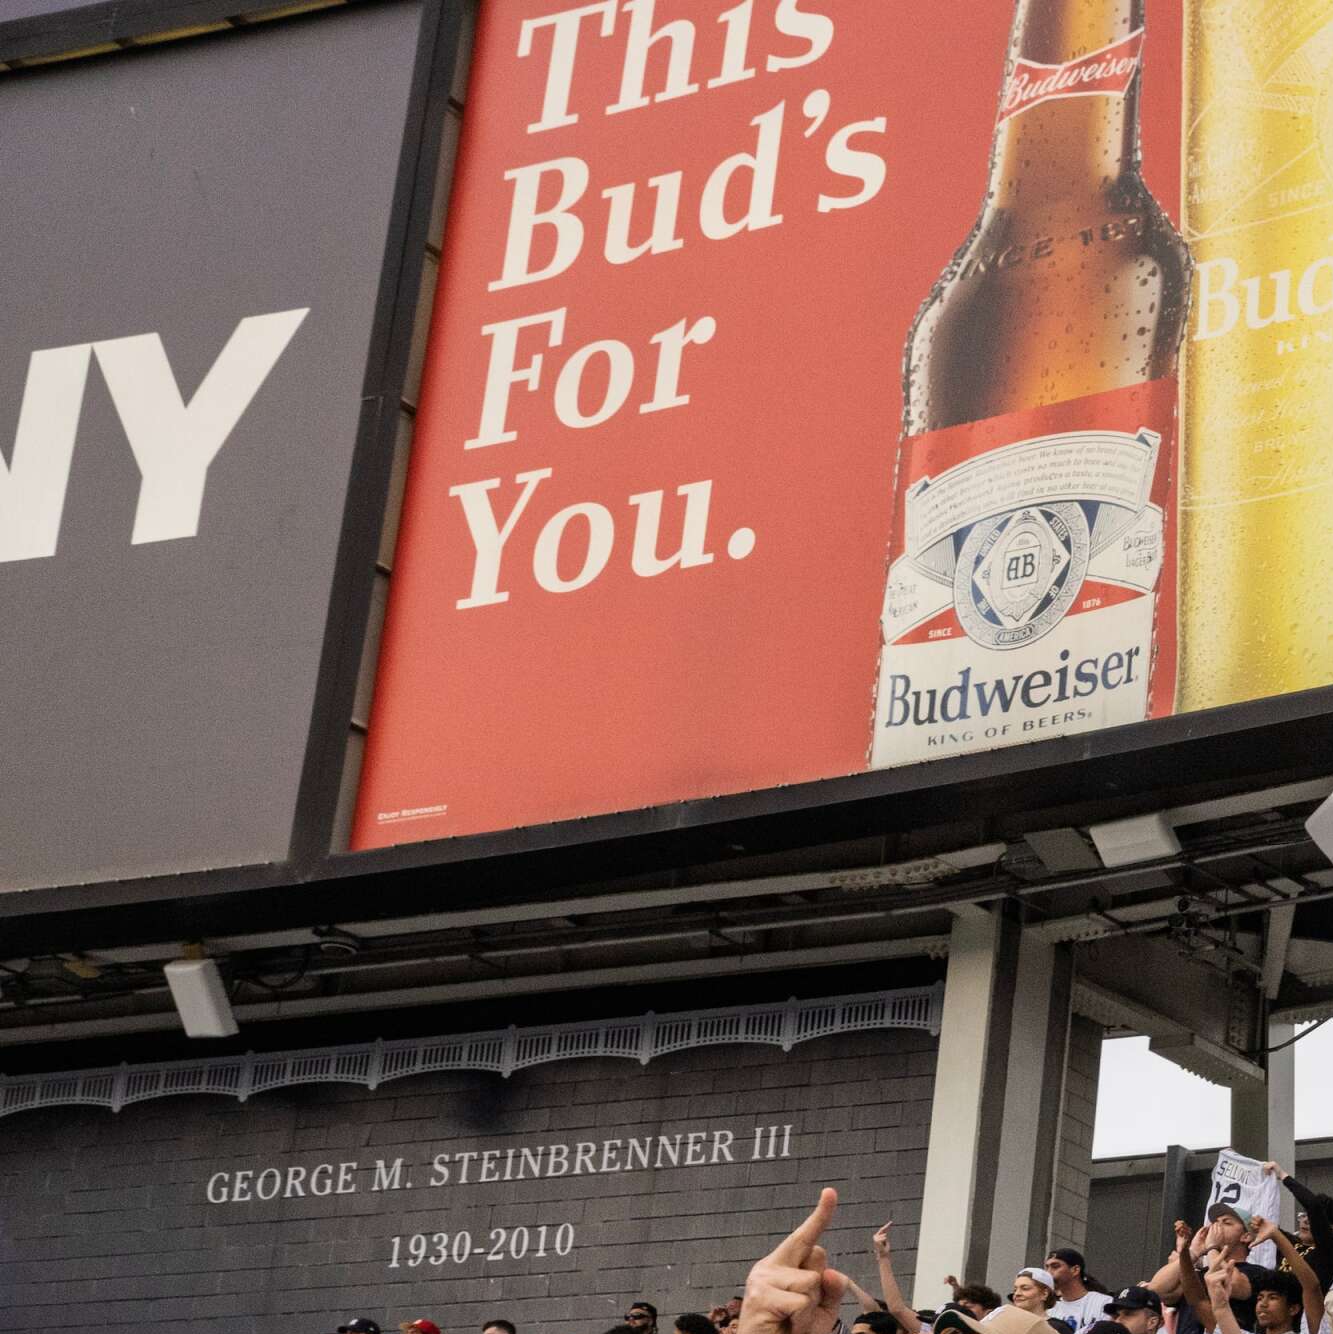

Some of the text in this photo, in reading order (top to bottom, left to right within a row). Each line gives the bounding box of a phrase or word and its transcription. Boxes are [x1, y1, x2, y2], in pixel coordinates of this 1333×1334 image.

[517, 0, 834, 134] This
[1007, 54, 1139, 110] Budweiser
[488, 89, 888, 292] Bud's
[463, 307, 717, 450] For
[449, 468, 756, 611] You.
[928, 627, 953, 638] SINCE
[885, 646, 1140, 728] Budweiser
[927, 730, 973, 746] KING
[985, 724, 1011, 738] OF
[207, 1124, 793, 1204] GEORGE M. STEINBRENNER III
[1214, 1181, 1241, 1204] 12
[388, 1222, 575, 1268] 1930-2010
